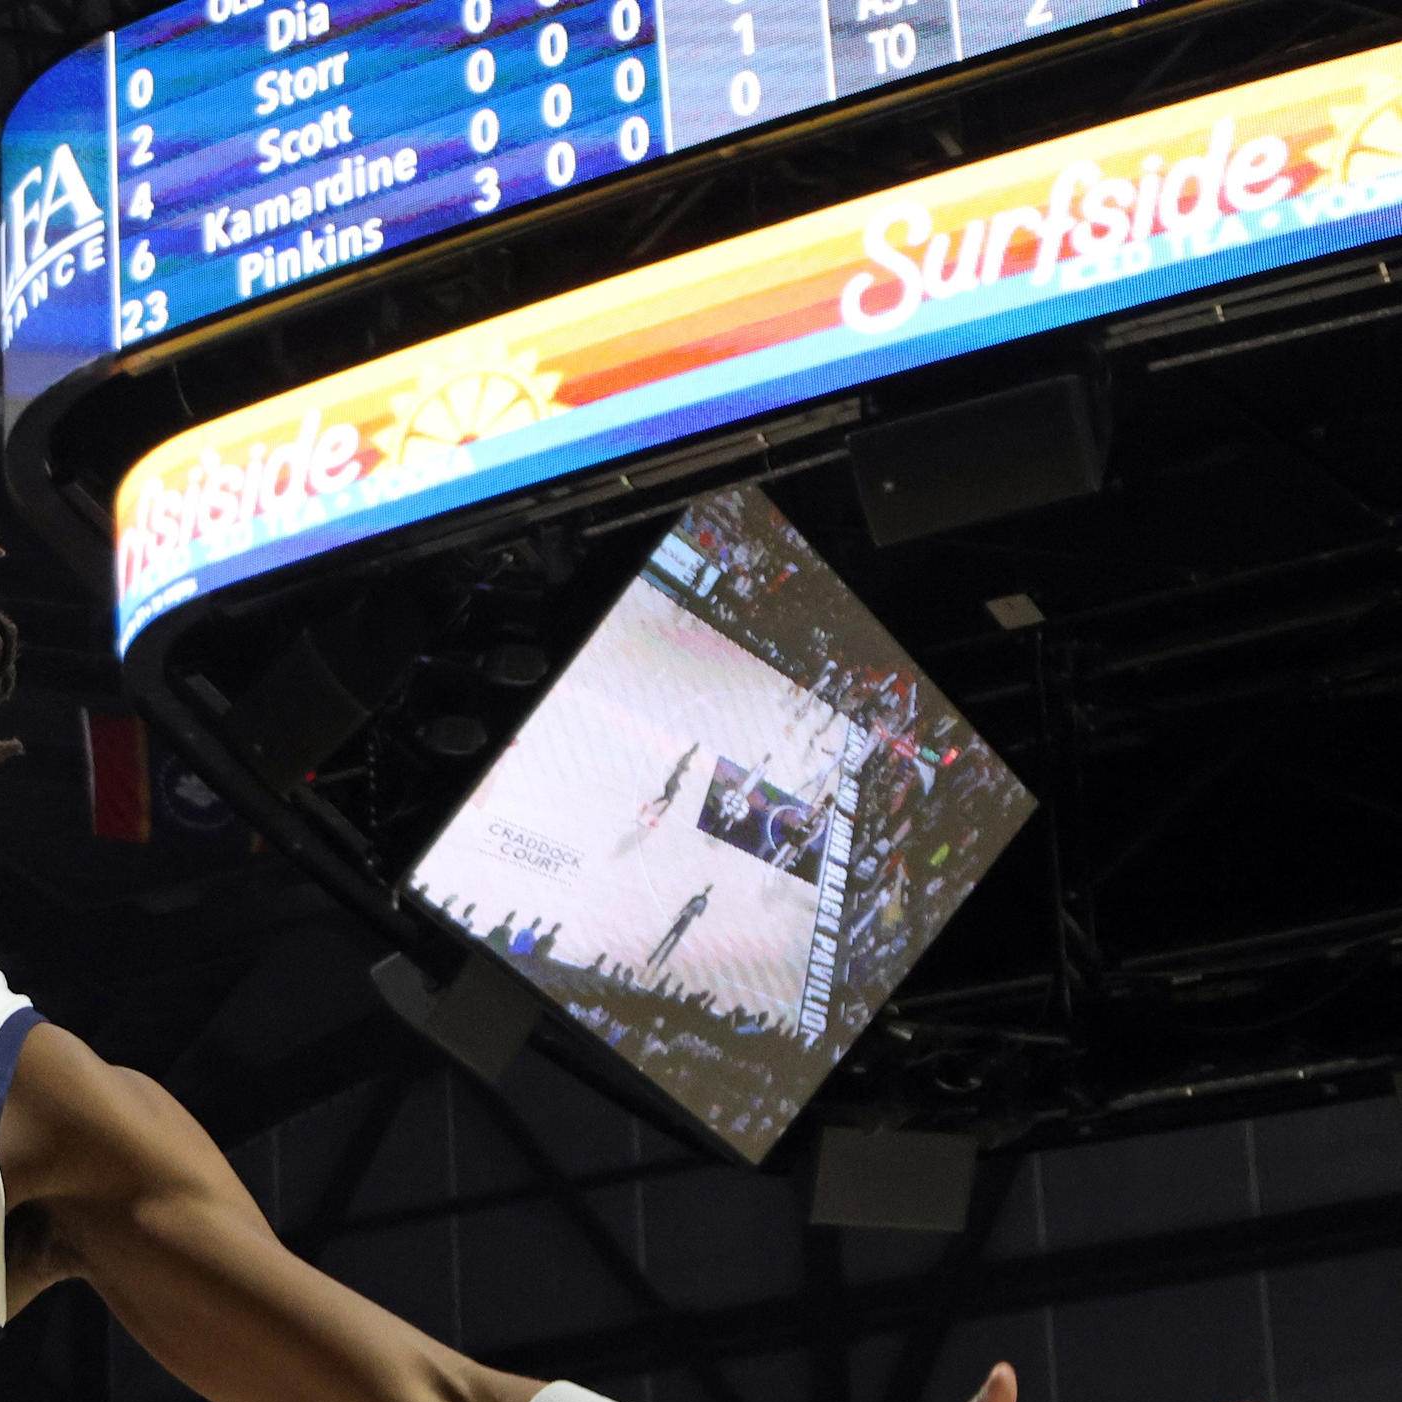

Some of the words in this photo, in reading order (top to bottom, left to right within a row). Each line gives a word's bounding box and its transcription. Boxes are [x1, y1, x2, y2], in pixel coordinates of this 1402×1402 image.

[128, 68, 153, 108] 0
[269, 3, 330, 51] Dia
[129, 182, 154, 220] 4
[258, 105, 353, 173] Scott
[467, 49, 496, 93] 0
[539, 22, 568, 67] 0
[612, 0, 641, 41] 0
[131, 125, 154, 166] 2
[256, 51, 349, 115] Storr
[464, 0, 492, 33] 0
[729, 70, 761, 116] 0
[867, 22, 916, 74] TO
[732, 12, 756, 55] 1
[122, 290, 168, 341] 23
[238, 217, 383, 298] Pinkins
[473, 167, 500, 213] 3
[547, 141, 576, 186] 0
[620, 116, 649, 161] 0
[132, 240, 155, 280] 6
[202, 147, 418, 252] Kamardine
[470, 108, 499, 153] 0
[543, 83, 572, 128] 0
[616, 57, 645, 102] 0
[841, 116, 1292, 334] Surfside
[500, 842, 563, 873] COURT
